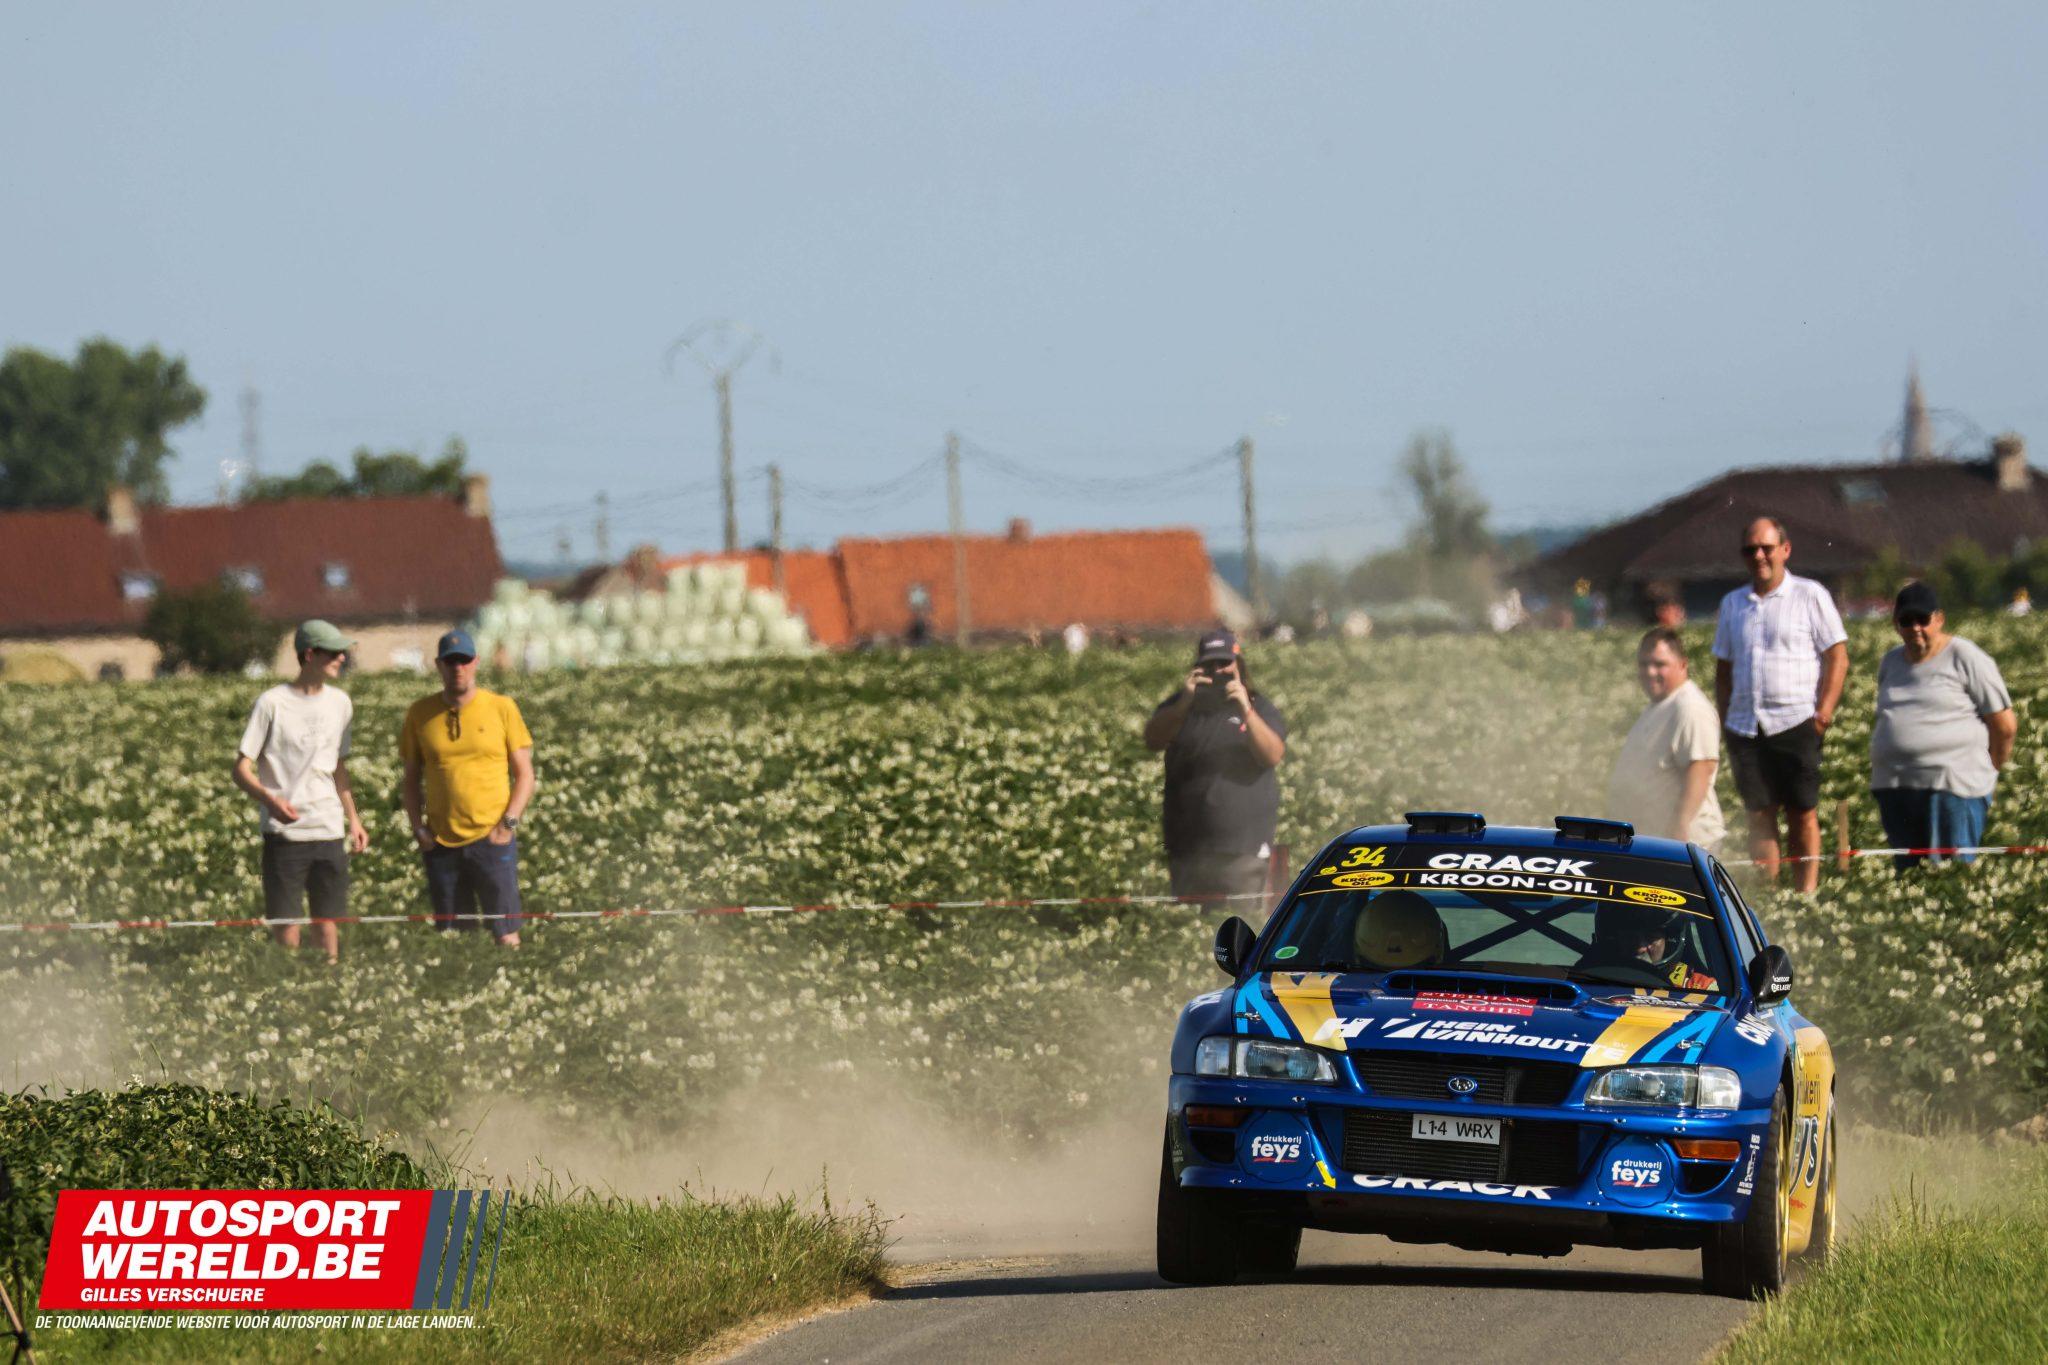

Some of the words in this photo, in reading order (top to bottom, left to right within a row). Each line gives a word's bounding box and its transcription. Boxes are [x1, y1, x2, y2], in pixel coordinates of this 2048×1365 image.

[1341, 846, 1388, 868] 34
[1428, 853, 1595, 877] CRACK
[1340, 876, 1386, 884] KROON
[1420, 873, 1599, 895] KROON-OIL
[1632, 890, 1678, 902] KROON
[1644, 896, 1664, 904] OIL
[1421, 991, 1531, 1004] STEPHAN
[1422, 1002, 1522, 1015] TANGHE
[1430, 1020, 1517, 1033] HEIN
[1420, 1028, 1626, 1060] VANHOUTTE
[1417, 1119, 1448, 1136] L14
[1455, 1121, 1495, 1140] WRX
[1263, 1134, 1302, 1145] drukkerij
[1251, 1136, 1300, 1164] feys
[1623, 1159, 1663, 1171] drukkerij
[1611, 1160, 1661, 1188] feys
[1352, 1173, 1560, 1200] CRACK
